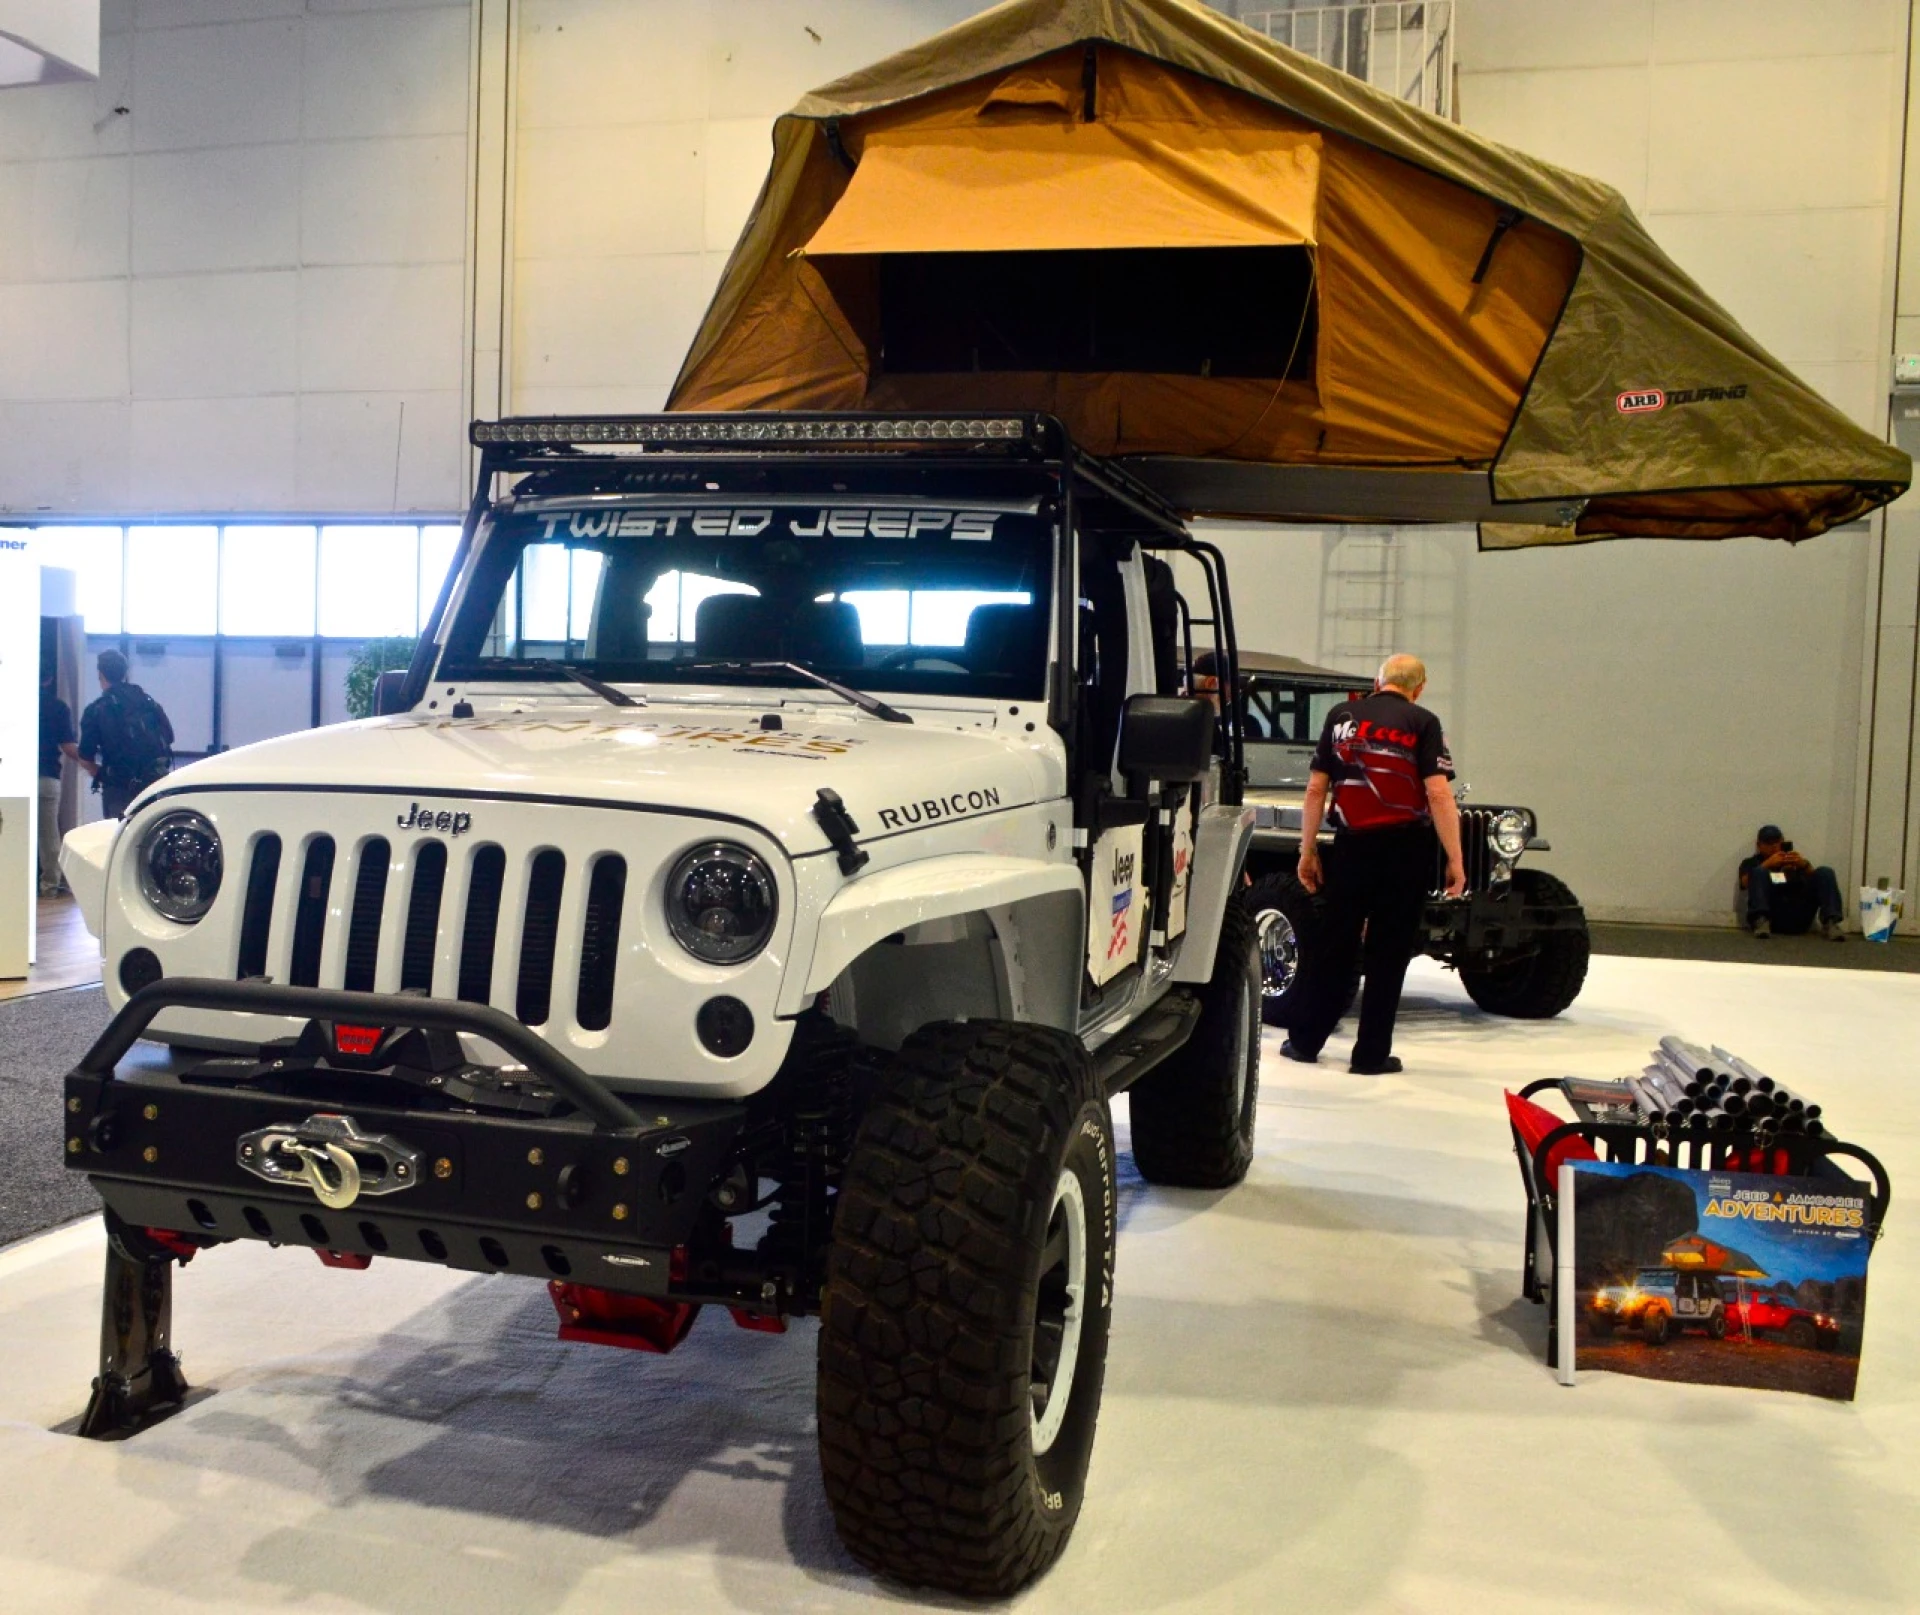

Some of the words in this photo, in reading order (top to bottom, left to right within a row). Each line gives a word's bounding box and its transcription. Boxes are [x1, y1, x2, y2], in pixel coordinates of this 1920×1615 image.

[1622, 393, 1659, 409] ARB
[1664, 384, 1748, 405] TOURING
[536, 509, 773, 540] TWISTED
[790, 511, 1000, 541] JEEPS
[397, 802, 473, 838] Jeep
[878, 787, 1000, 829] RUBICON
[1732, 1189, 1770, 1202] JEEP
[1703, 1198, 1864, 1228] ADVENTURES
